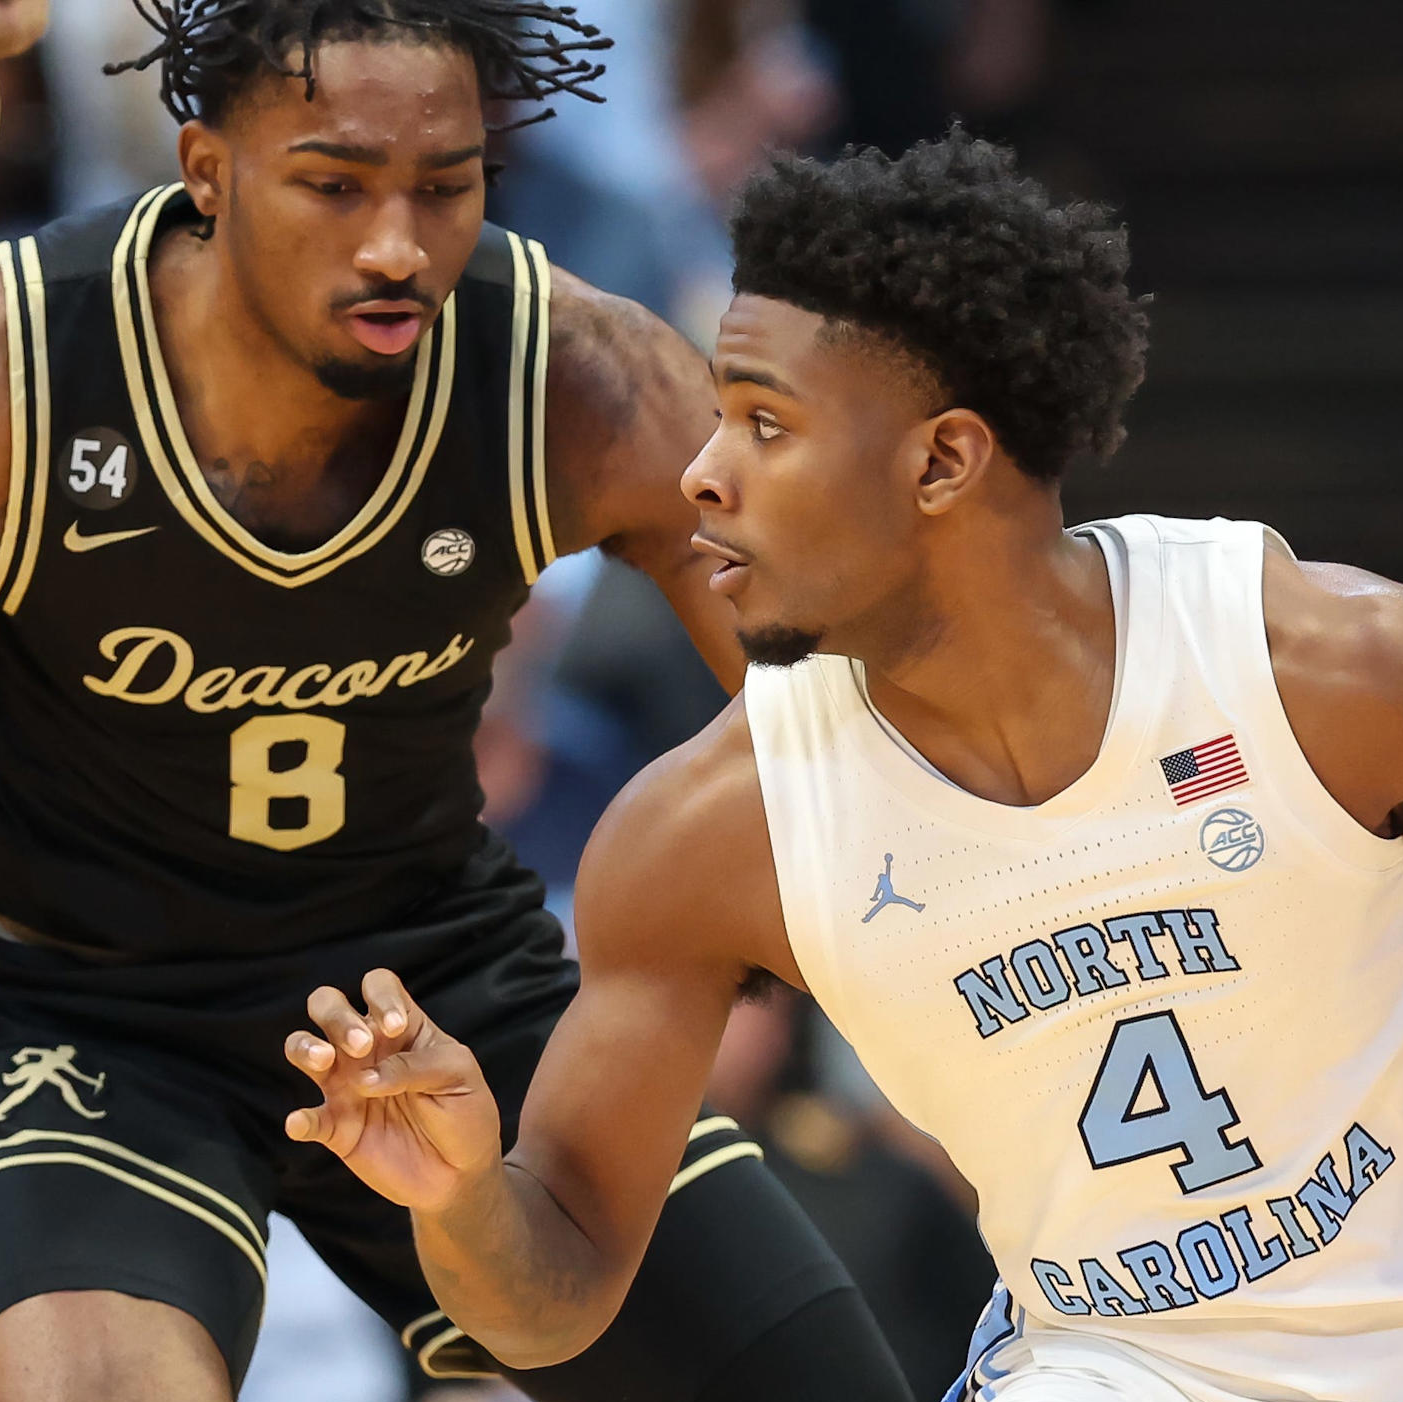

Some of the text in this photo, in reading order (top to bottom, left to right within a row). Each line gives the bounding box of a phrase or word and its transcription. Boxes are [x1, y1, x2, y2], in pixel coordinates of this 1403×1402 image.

[68, 438, 128, 499] 54
[429, 541, 470, 557] ACC
[83, 626, 475, 713] Deacons
[229, 713, 346, 852] 8
[1211, 821, 1256, 849] ACC
[953, 908, 1242, 1040] NORTH
[1077, 1009, 1264, 1196] 4
[1030, 1121, 1396, 1318] CAROLINA
